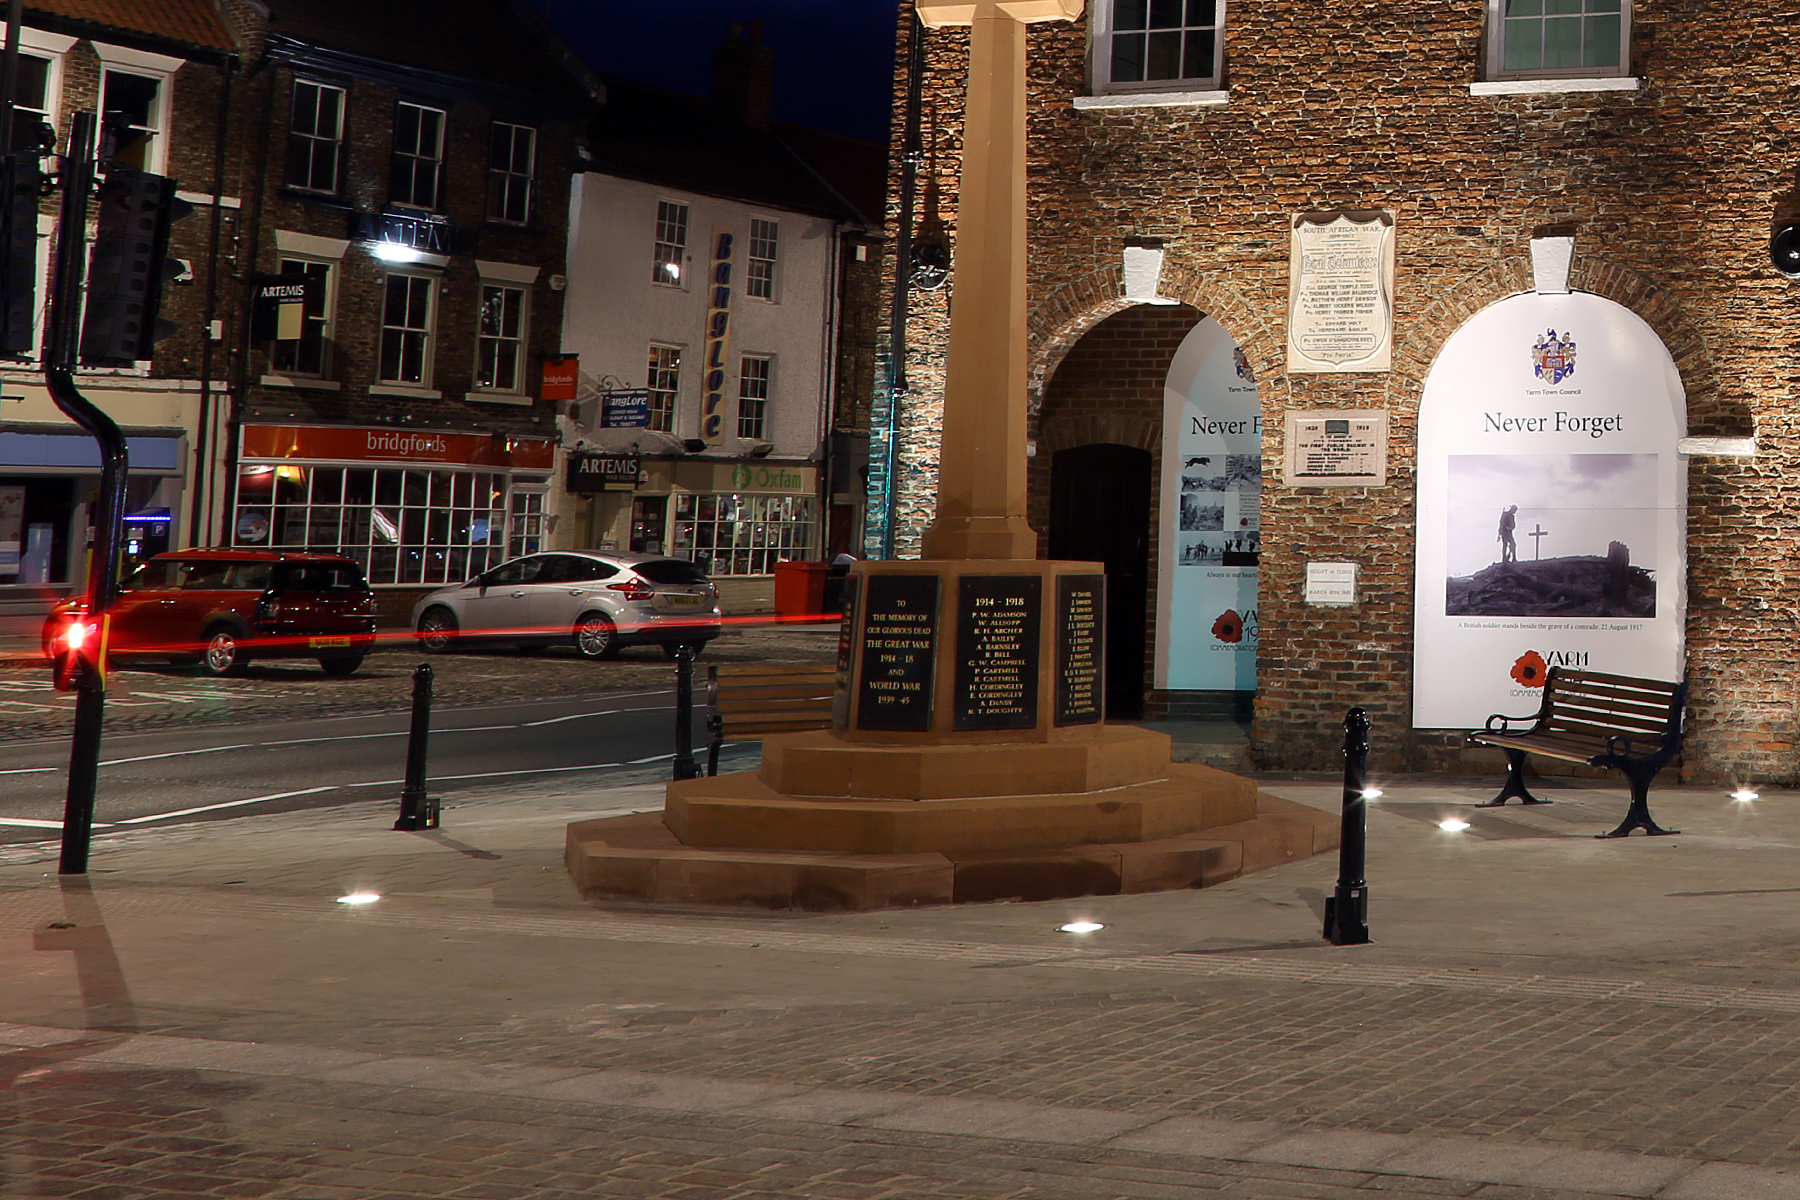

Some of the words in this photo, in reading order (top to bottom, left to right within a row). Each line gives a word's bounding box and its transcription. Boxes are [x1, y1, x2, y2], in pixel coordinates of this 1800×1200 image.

[261, 285, 304, 297] ARTEMIS
[1191, 416, 1246, 434] Never
[1484, 412, 1547, 432] Never
[1554, 411, 1623, 438] Forget
[367, 432, 447, 455] bridgfords
[580, 459, 637, 474] ARTEMIS
[756, 468, 802, 489] Oxfam
[155, 525, 163, 533] P
[976, 598, 994, 606] 1914
[1005, 598, 1024, 606] 1918
[918, 614, 928, 622] OF
[914, 627, 931, 635] DEAD
[866, 640, 883, 648] THE
[885, 640, 911, 648] GREAT
[912, 641, 930, 649] WAR
[880, 655, 896, 663] 1914
[1542, 651, 1588, 667] YARM
[869, 682, 900, 690] WORLD
[902, 682, 921, 690] WAR
[878, 696, 894, 704] 1939
